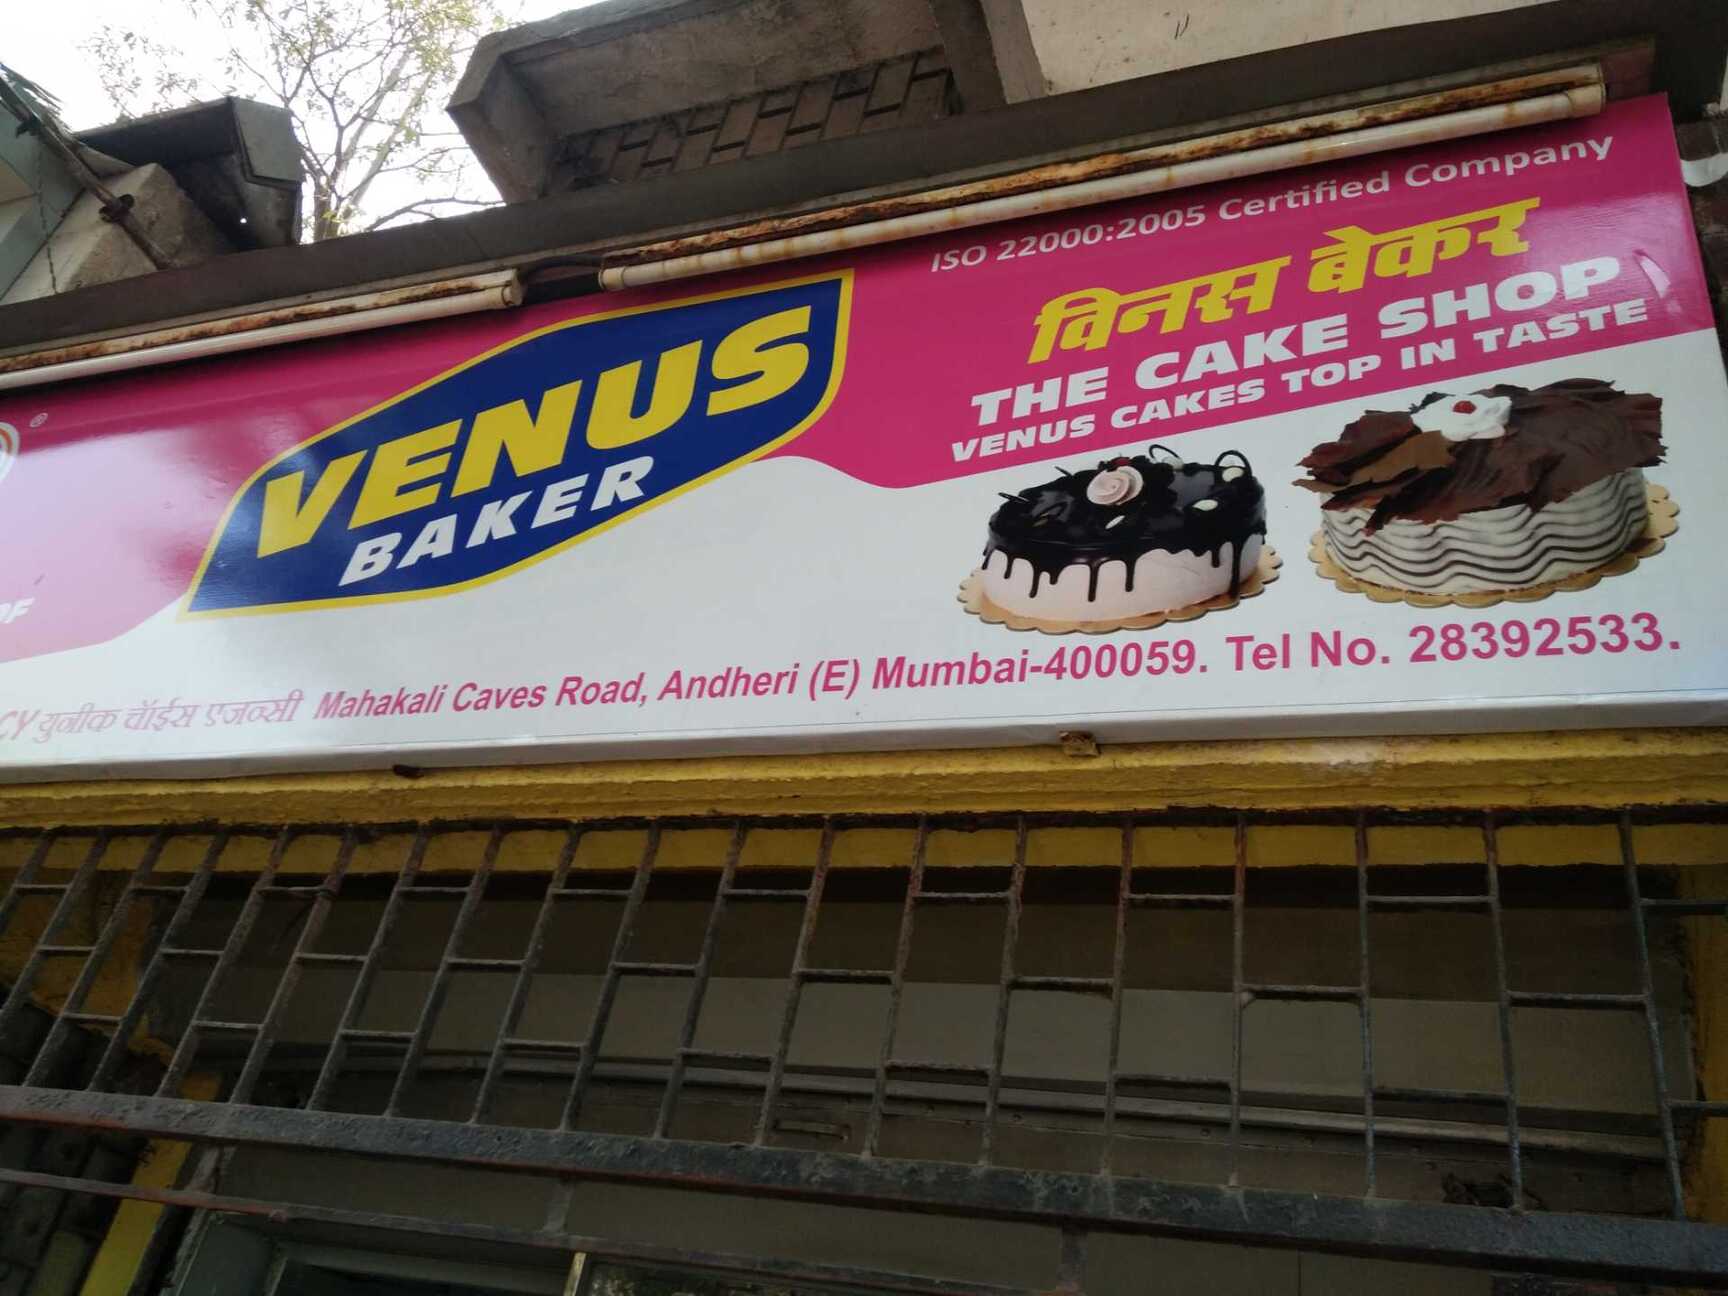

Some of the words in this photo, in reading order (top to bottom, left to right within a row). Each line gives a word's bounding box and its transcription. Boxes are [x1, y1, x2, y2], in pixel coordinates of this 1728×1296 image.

[931, 246, 987, 272] ISO
[996, 205, 1206, 261] 22000:2005
[1219, 171, 1391, 220] Certified
[1404, 136, 1614, 188] Company
[1027, 257, 1292, 364] विनस
[1308, 197, 1541, 294] बेकर
[951, 413, 1096, 462] VENUS
[1110, 378, 1266, 427] CAKES
[1281, 353, 1383, 393] TOP
[1400, 338, 1457, 370] IN
[1472, 296, 1649, 354] TASTE
[970, 366, 1109, 427] THE
[1134, 313, 1349, 391] CAKE
[1378, 256, 1622, 340] SHOP
[257, 305, 812, 560] VENUS
[338, 455, 656, 588] BAKER
[315, 684, 444, 720] Mahakali
[450, 681, 547, 713] Caves
[555, 672, 648, 708] Road,
[658, 662, 798, 702] Andheri
[807, 658, 861, 702] (E)
[871, 639, 1208, 690] Mumbai-400059.
[1225, 633, 1292, 674] Tel
[1309, 629, 1390, 669] No.
[1408, 611, 1681, 665] 28392533.
